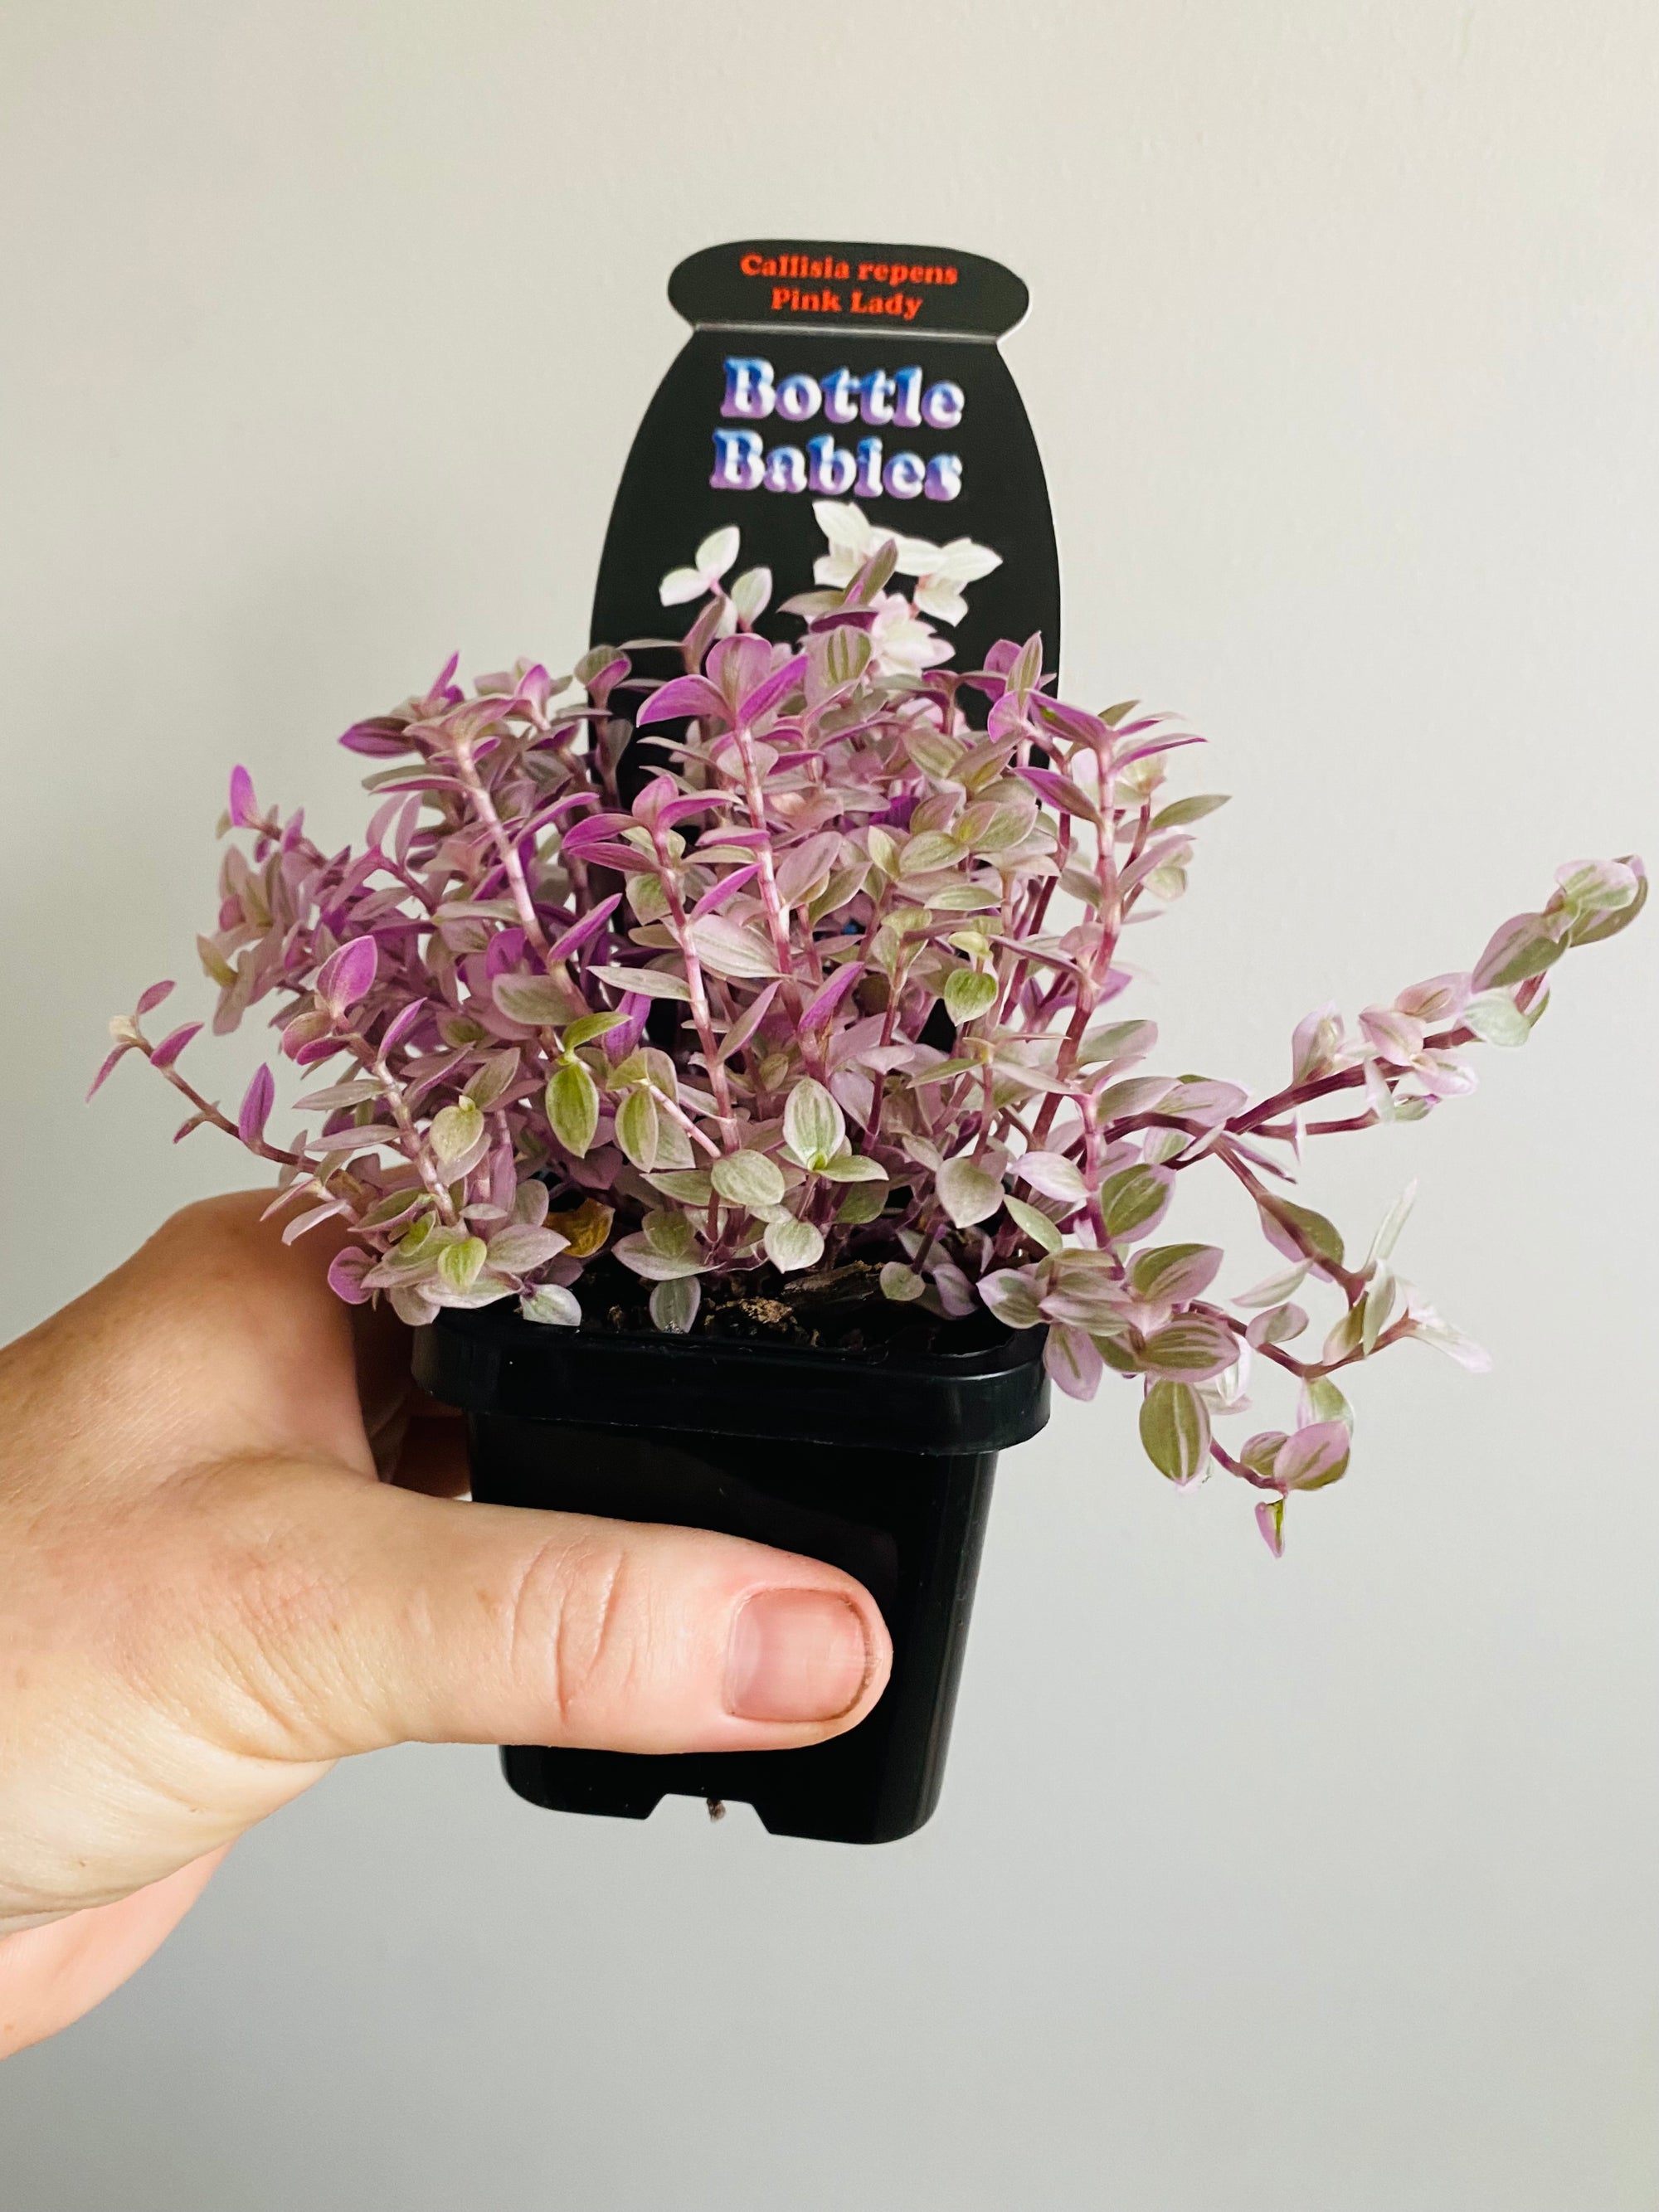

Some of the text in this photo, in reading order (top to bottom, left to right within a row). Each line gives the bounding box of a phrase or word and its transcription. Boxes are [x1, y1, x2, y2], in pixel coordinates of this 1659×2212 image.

[740, 252, 958, 287] Callisia repens
[771, 286, 923, 321] Pink Lady
[720, 356, 965, 430] Bottle
[709, 428, 963, 501] Babies
